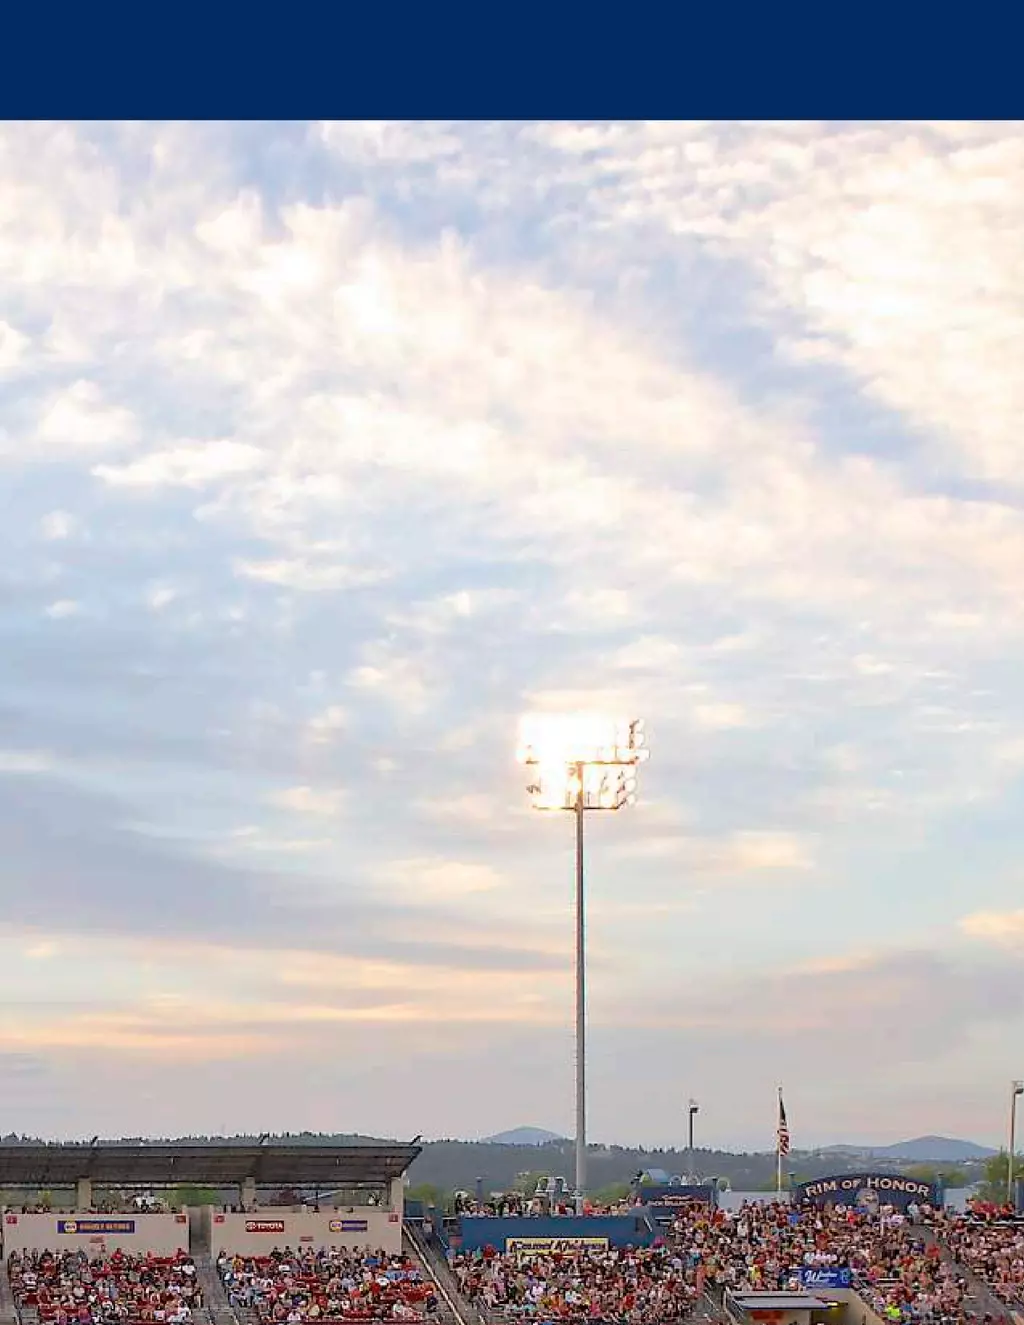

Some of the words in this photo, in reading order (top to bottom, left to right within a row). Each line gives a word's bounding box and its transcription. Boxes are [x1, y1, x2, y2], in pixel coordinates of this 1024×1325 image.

[805, 1180, 837, 1198] RIM
[842, 1178, 862, 1190] OF
[867, 1177, 930, 1198] HONOR
